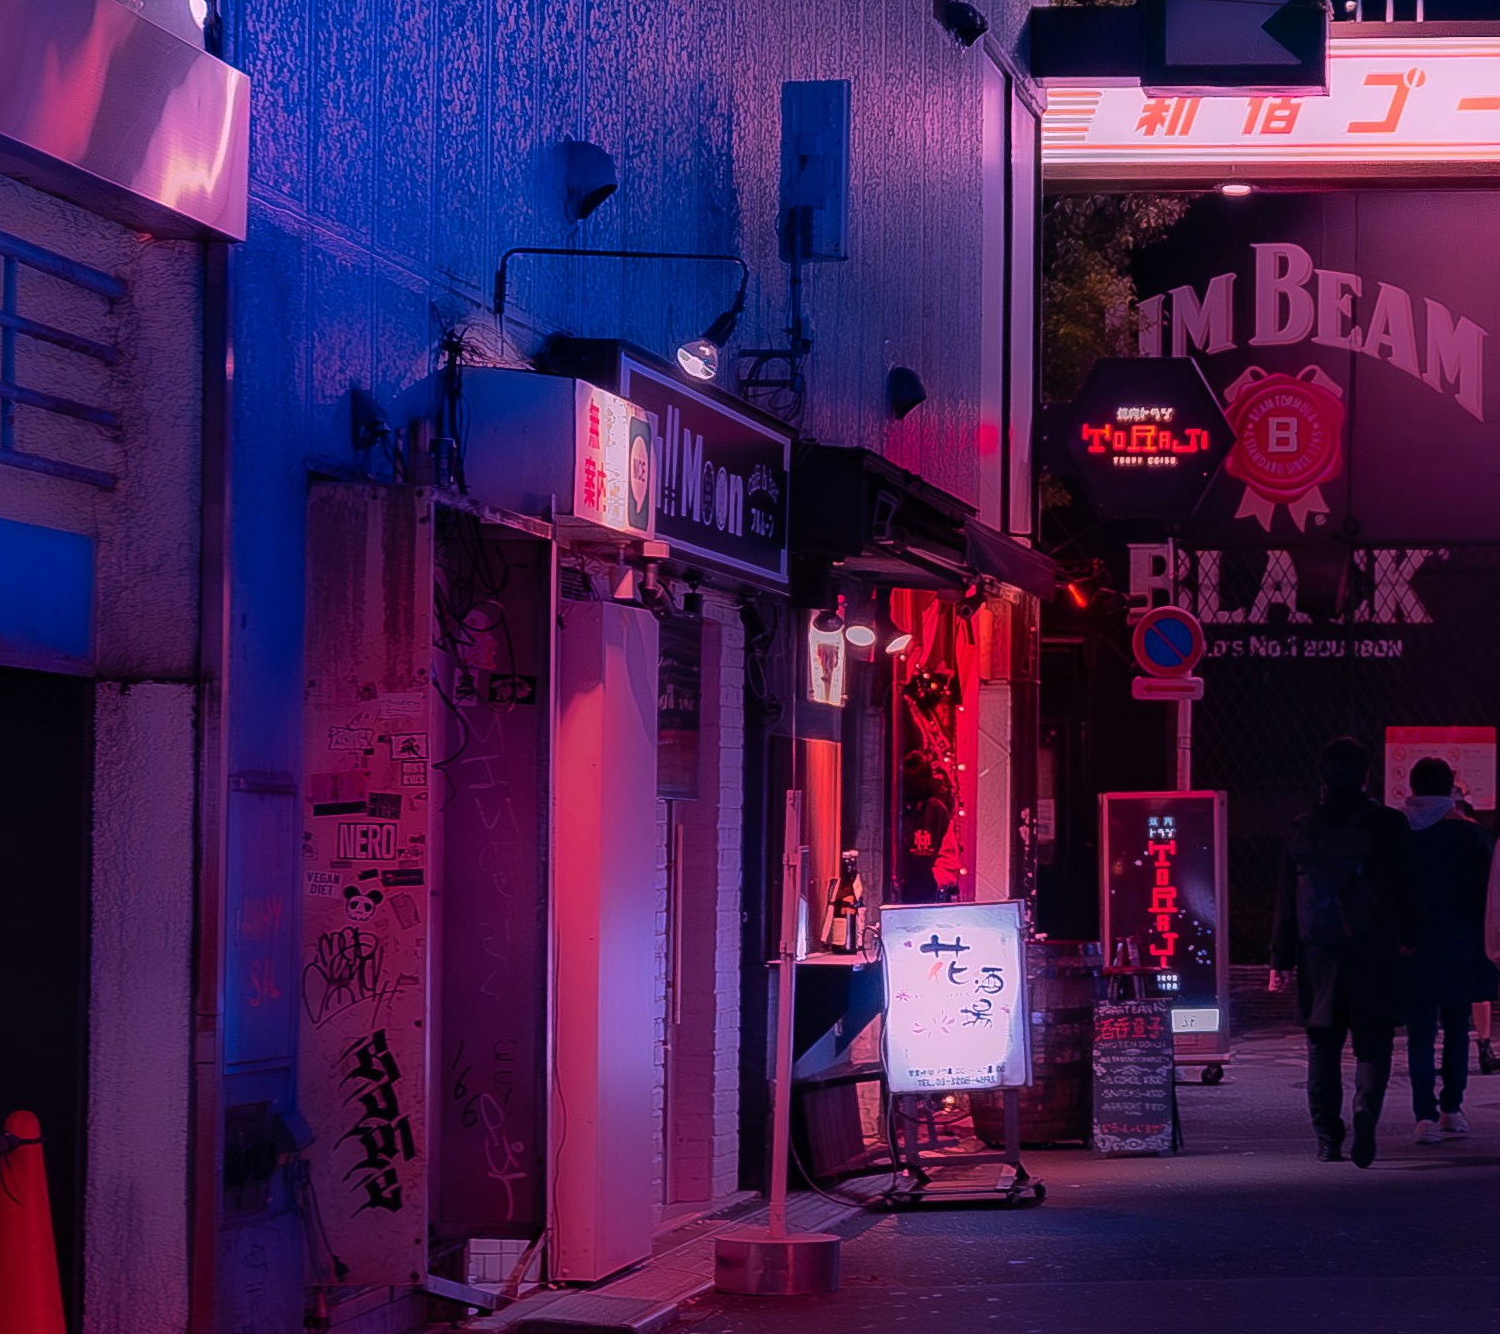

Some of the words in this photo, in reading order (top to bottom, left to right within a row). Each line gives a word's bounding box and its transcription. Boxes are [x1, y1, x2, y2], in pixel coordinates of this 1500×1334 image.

[1105, 272, 1239, 357] IM
[1248, 242, 1488, 424] BEAM
[1081, 422, 1210, 454] TORAJI
[1267, 416, 1298, 453] B
[681, 427, 744, 538] Moon
[1304, 639, 1404, 658] BOUBON
[340, 823, 397, 860] NERO
[306, 870, 341, 886] VEGAN
[309, 882, 335, 897] DIET
